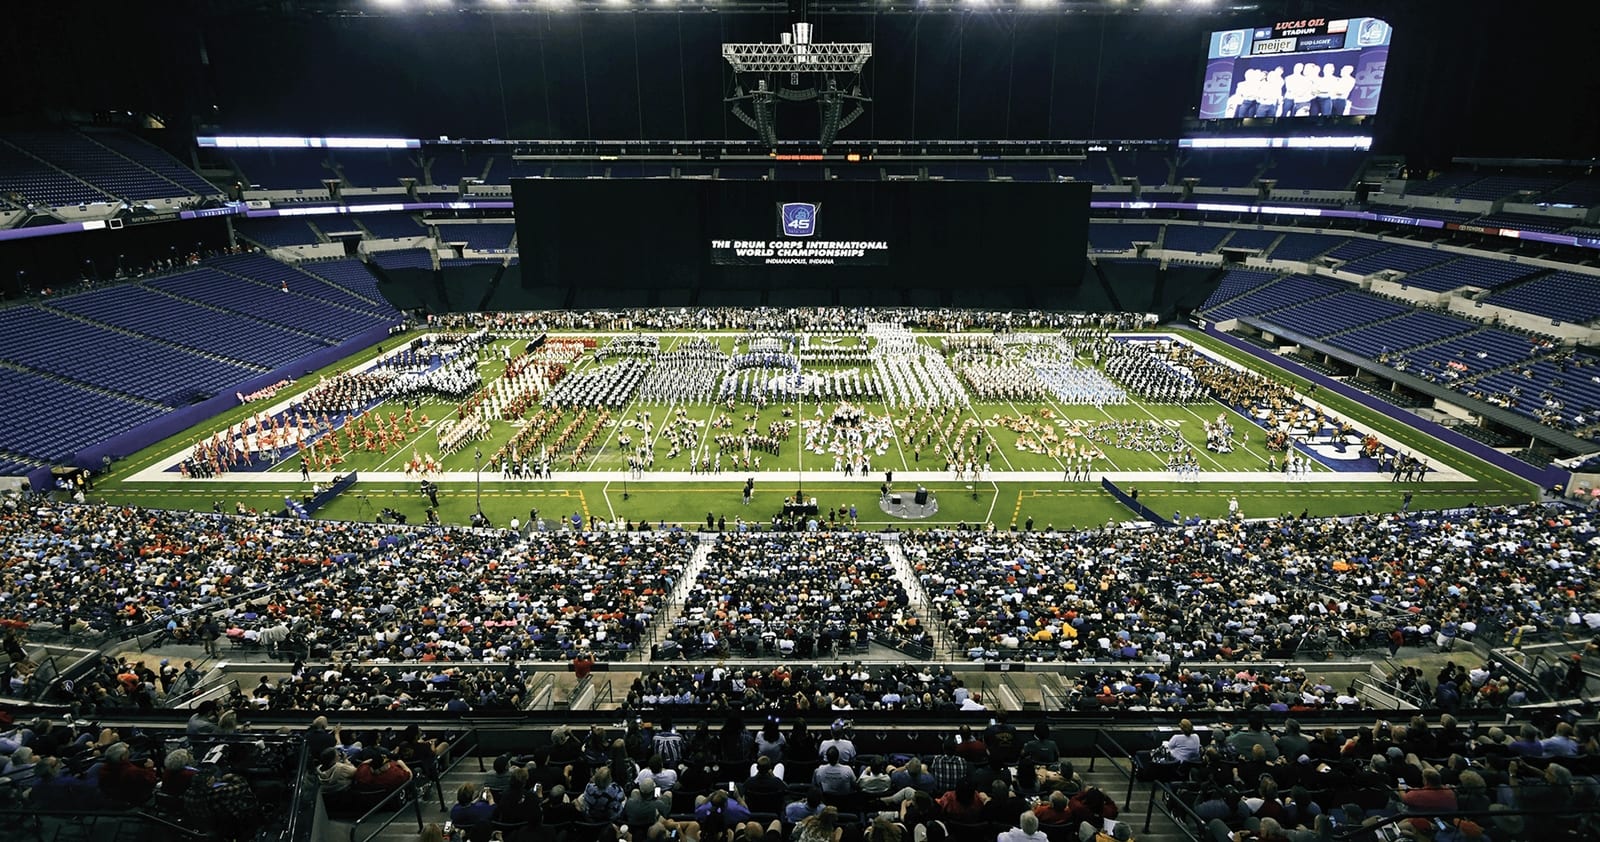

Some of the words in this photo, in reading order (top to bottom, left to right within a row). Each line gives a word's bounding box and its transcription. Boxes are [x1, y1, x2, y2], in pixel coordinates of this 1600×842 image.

[1275, 20, 1307, 30] LUCAS
[1307, 18, 1326, 27] OIL
[1282, 28, 1316, 36] STADIUM
[1257, 39, 1292, 52] meijer
[788, 219, 810, 229] 45
[711, 240, 731, 249] THE
[733, 240, 766, 249] DRUM
[768, 241, 804, 249] CORPS
[806, 241, 888, 249] INTERNATIONAL
[735, 248, 775, 257] WORLD
[777, 248, 865, 257] CHAMPIONSHIPS
